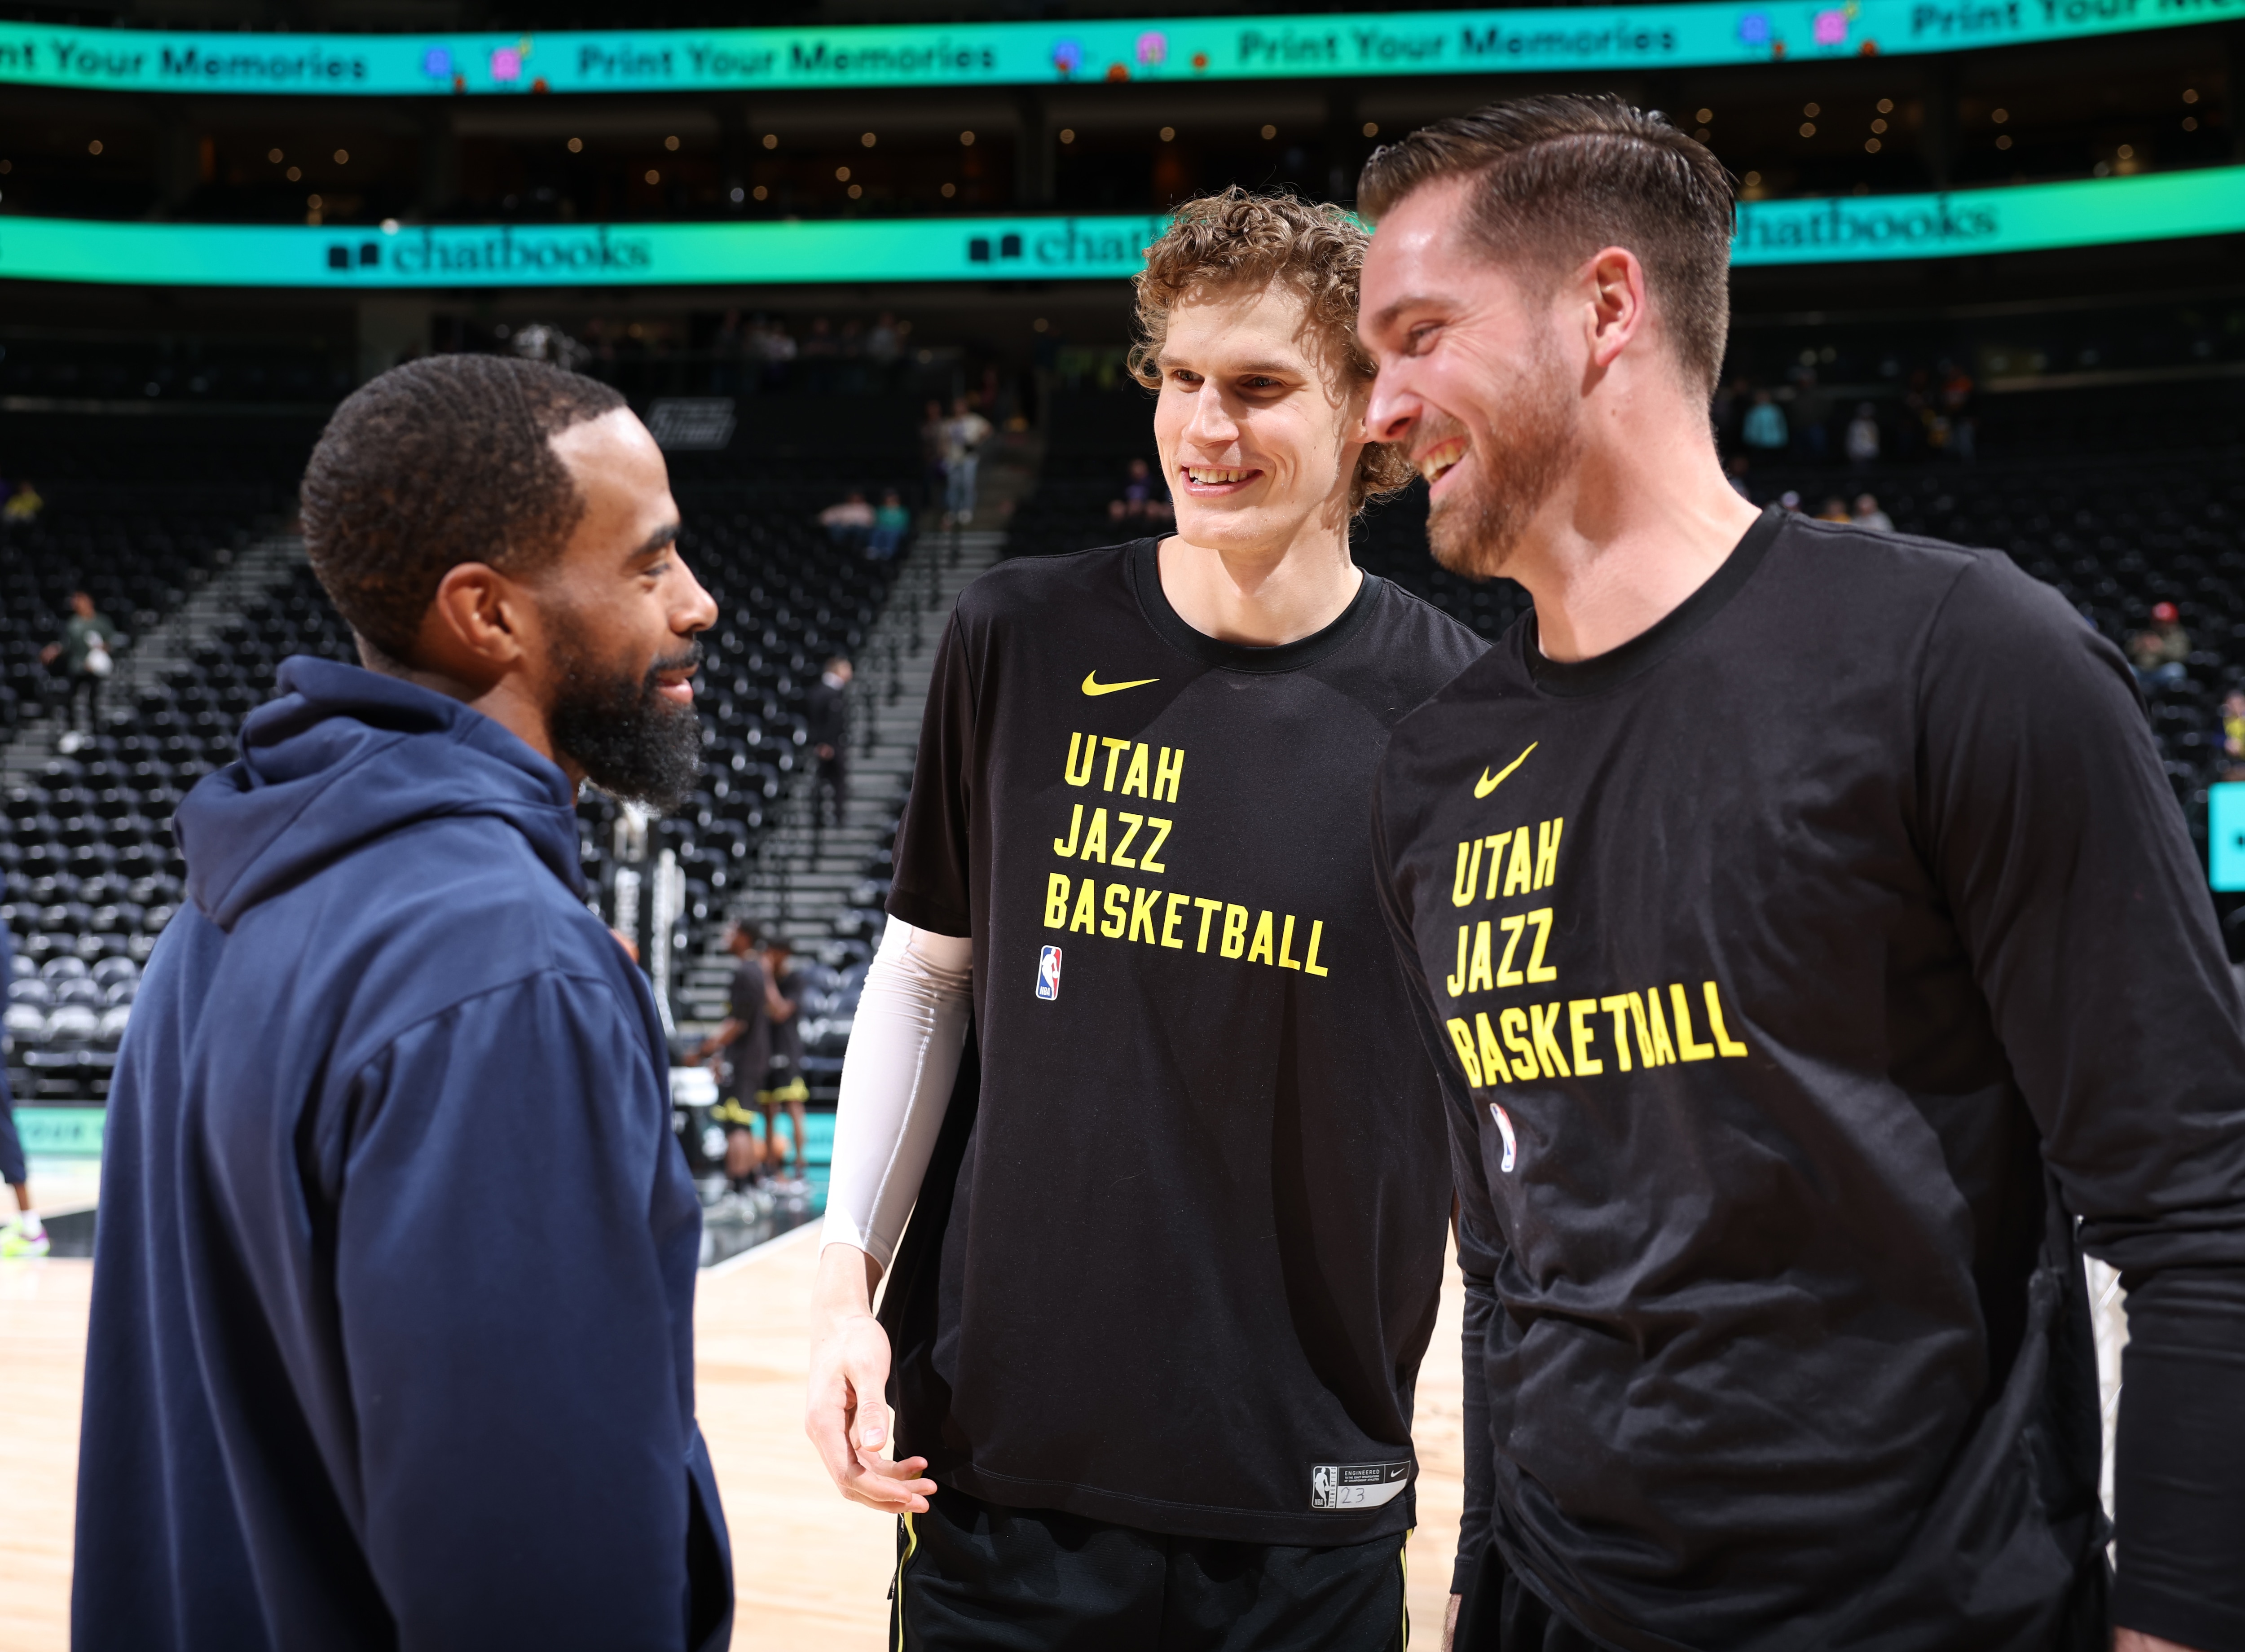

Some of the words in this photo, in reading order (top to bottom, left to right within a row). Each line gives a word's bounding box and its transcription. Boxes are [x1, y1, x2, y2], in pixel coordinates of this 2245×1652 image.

[1236, 28, 1340, 64] Print
[1349, 26, 1442, 63] Your
[1457, 19, 1675, 56] Memories
[1908, 2, 2021, 40] Print
[48, 38, 146, 78] Your
[157, 44, 367, 82] Memories
[577, 43, 673, 78] Print
[684, 42, 773, 76] Your
[787, 37, 995, 75] Memories
[1034, 215, 1162, 267] chat
[1737, 198, 1998, 249] hatbooks
[392, 224, 650, 275] chatbooks
[1065, 732, 1184, 803] UTAH
[1053, 804, 1172, 873] JAZZ
[1452, 817, 1563, 907] UTAH
[1044, 873, 1328, 977] BASKETBALL
[1447, 907, 1557, 997] JAZZ
[1039, 986, 1050, 996] NBA
[1446, 981, 1748, 1088] BASKETBALL
[1341, 1487, 1365, 1504] 23
